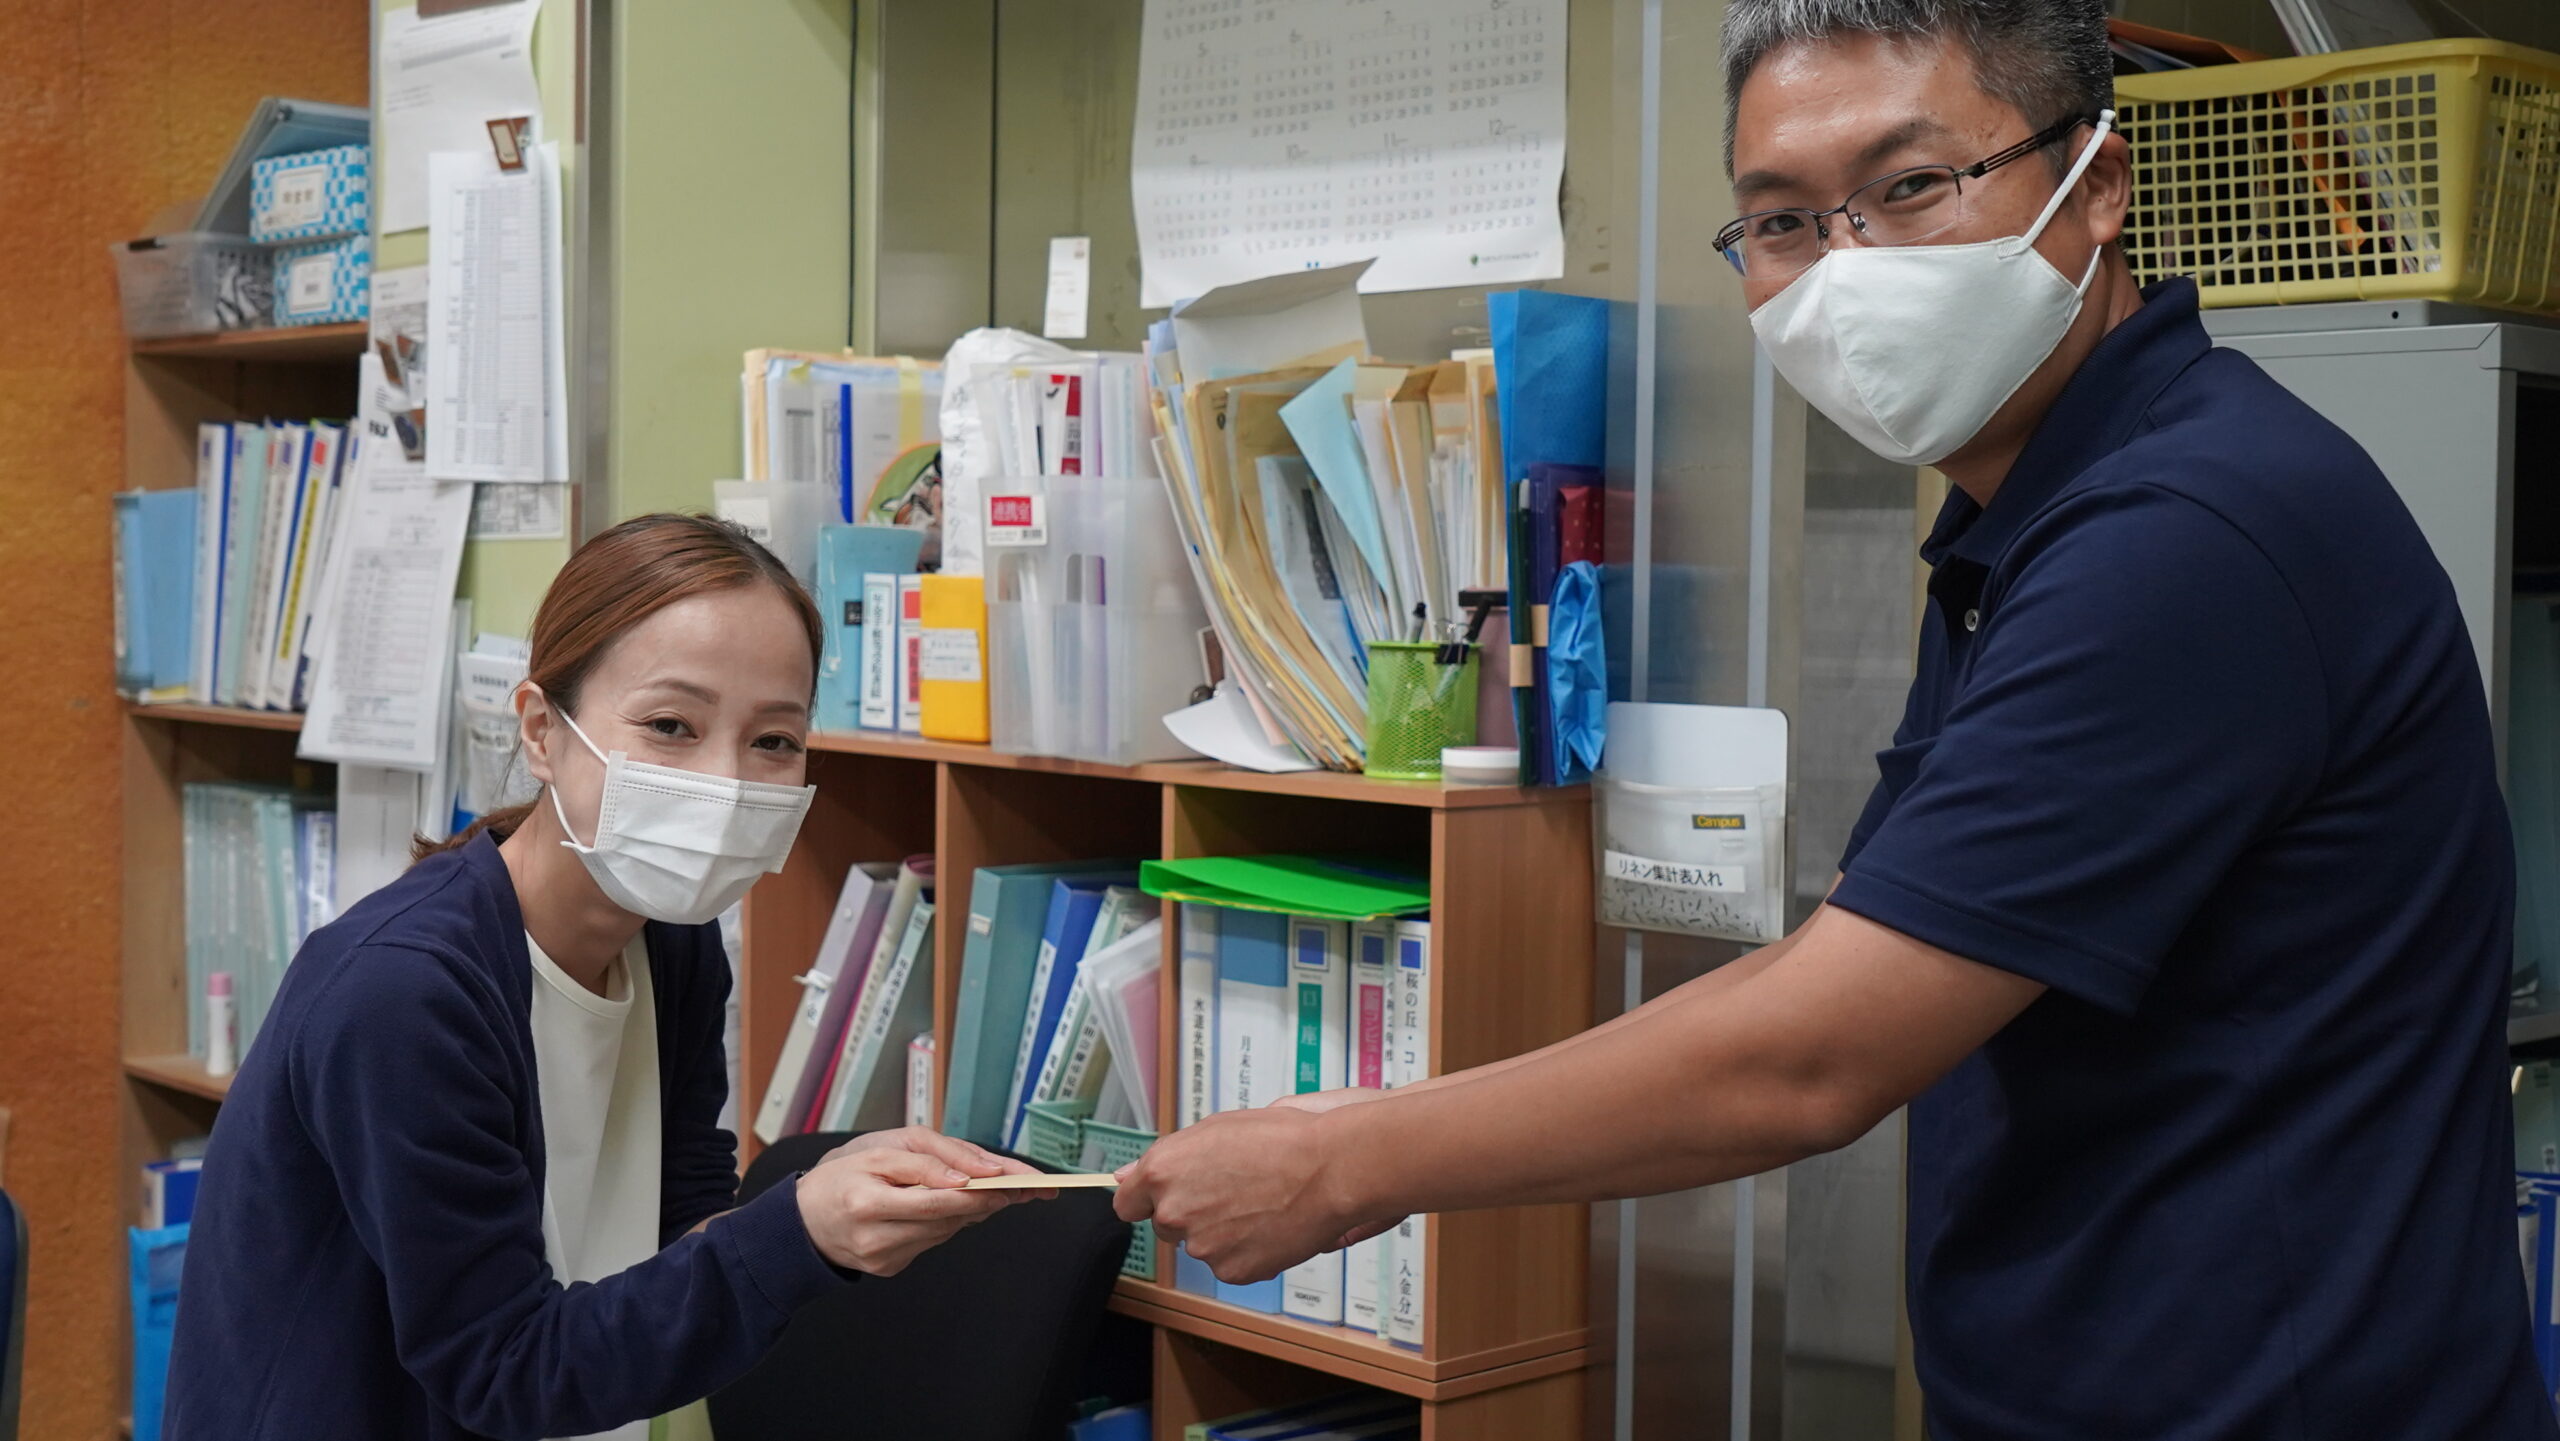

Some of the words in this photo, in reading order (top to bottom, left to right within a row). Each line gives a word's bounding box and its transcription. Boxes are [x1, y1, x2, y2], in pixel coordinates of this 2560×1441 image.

[1488, 119, 1503, 136] 12
[1697, 816, 1741, 828] Campus
[1619, 859, 1723, 887] リネン集計表入れ
[1399, 1259, 1412, 1315] 入金分
